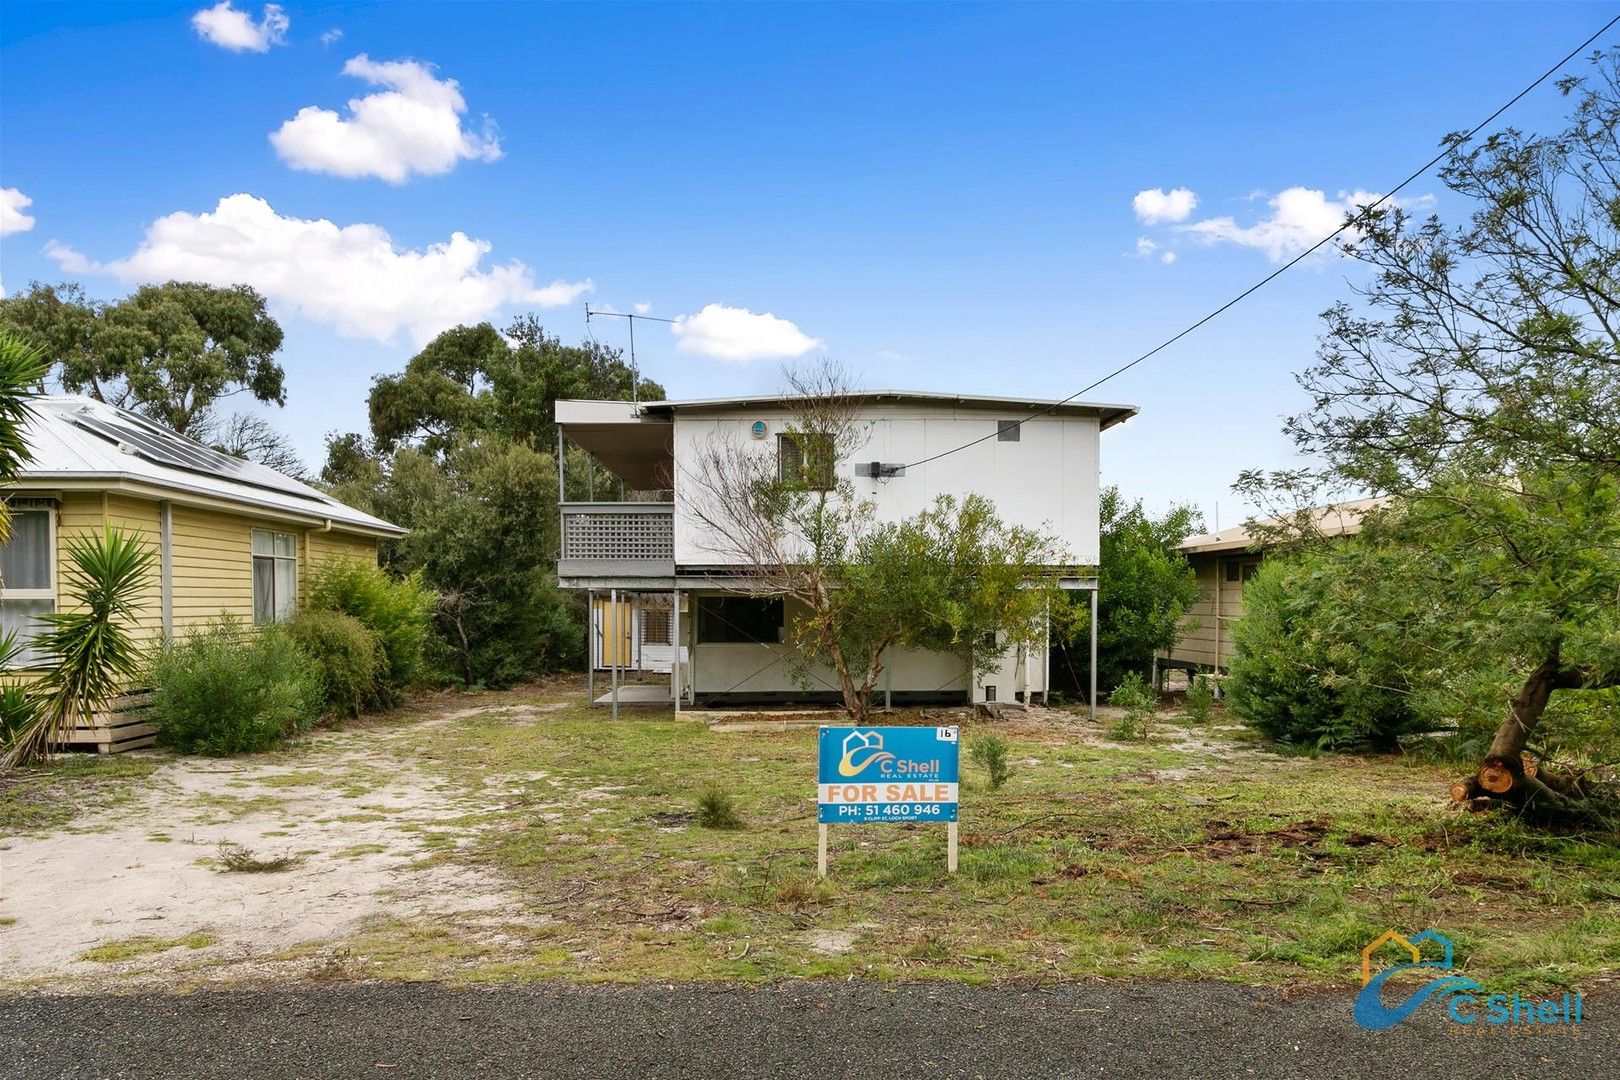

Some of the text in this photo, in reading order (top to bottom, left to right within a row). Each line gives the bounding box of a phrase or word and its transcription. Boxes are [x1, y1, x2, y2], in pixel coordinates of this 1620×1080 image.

[940, 729, 951, 738] 16
[880, 759, 940, 774] C Shell
[827, 784, 949, 802] FOR SALE
[839, 805, 940, 816] PH: 51 460 946
